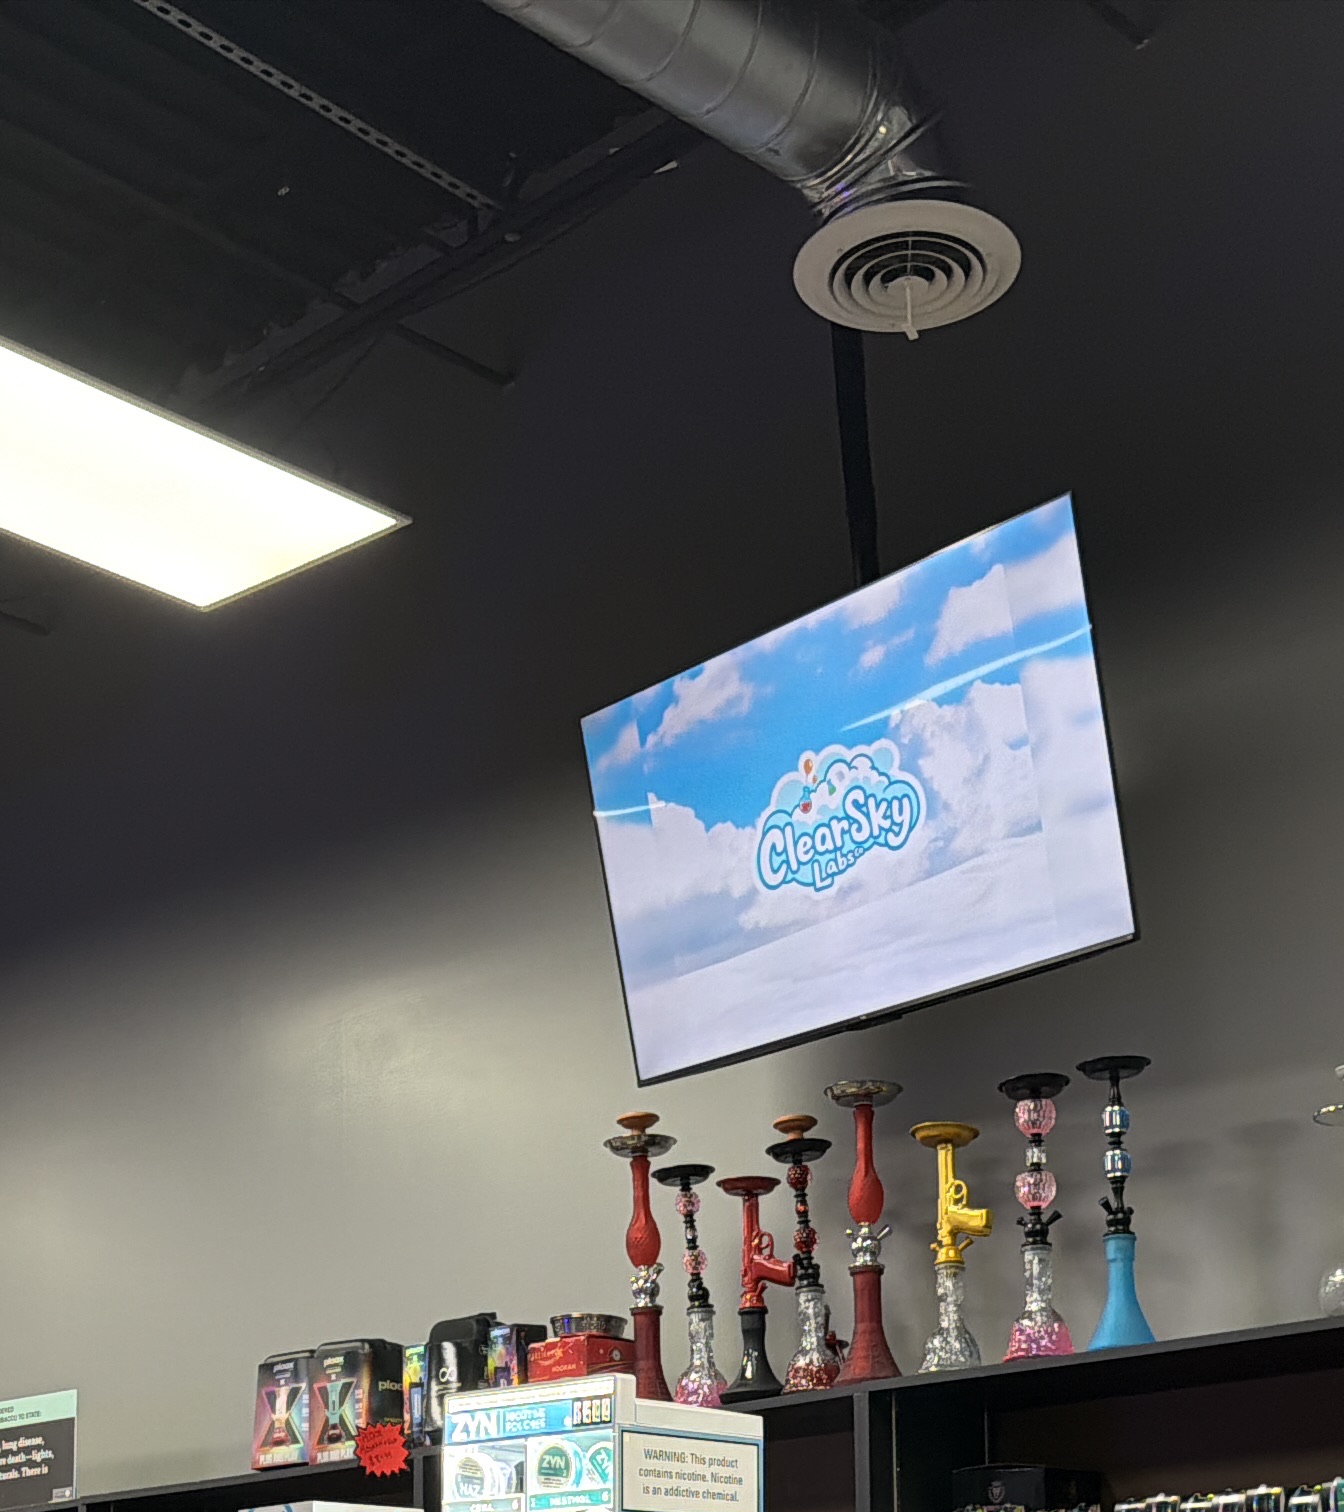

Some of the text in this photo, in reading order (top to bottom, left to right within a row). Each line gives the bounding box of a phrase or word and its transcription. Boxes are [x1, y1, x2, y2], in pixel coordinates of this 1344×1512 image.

[759, 788, 911, 886] ClearSky
[812, 851, 854, 889] Labs
[451, 1411, 497, 1441] ZYN
[542, 1456, 566, 1468] ZYN
[644, 1448, 738, 1469] WARNING: This product
[639, 1466, 743, 1485] contains nicotine. Nicotine
[643, 1484, 739, 1502] is an addictive chemical.
